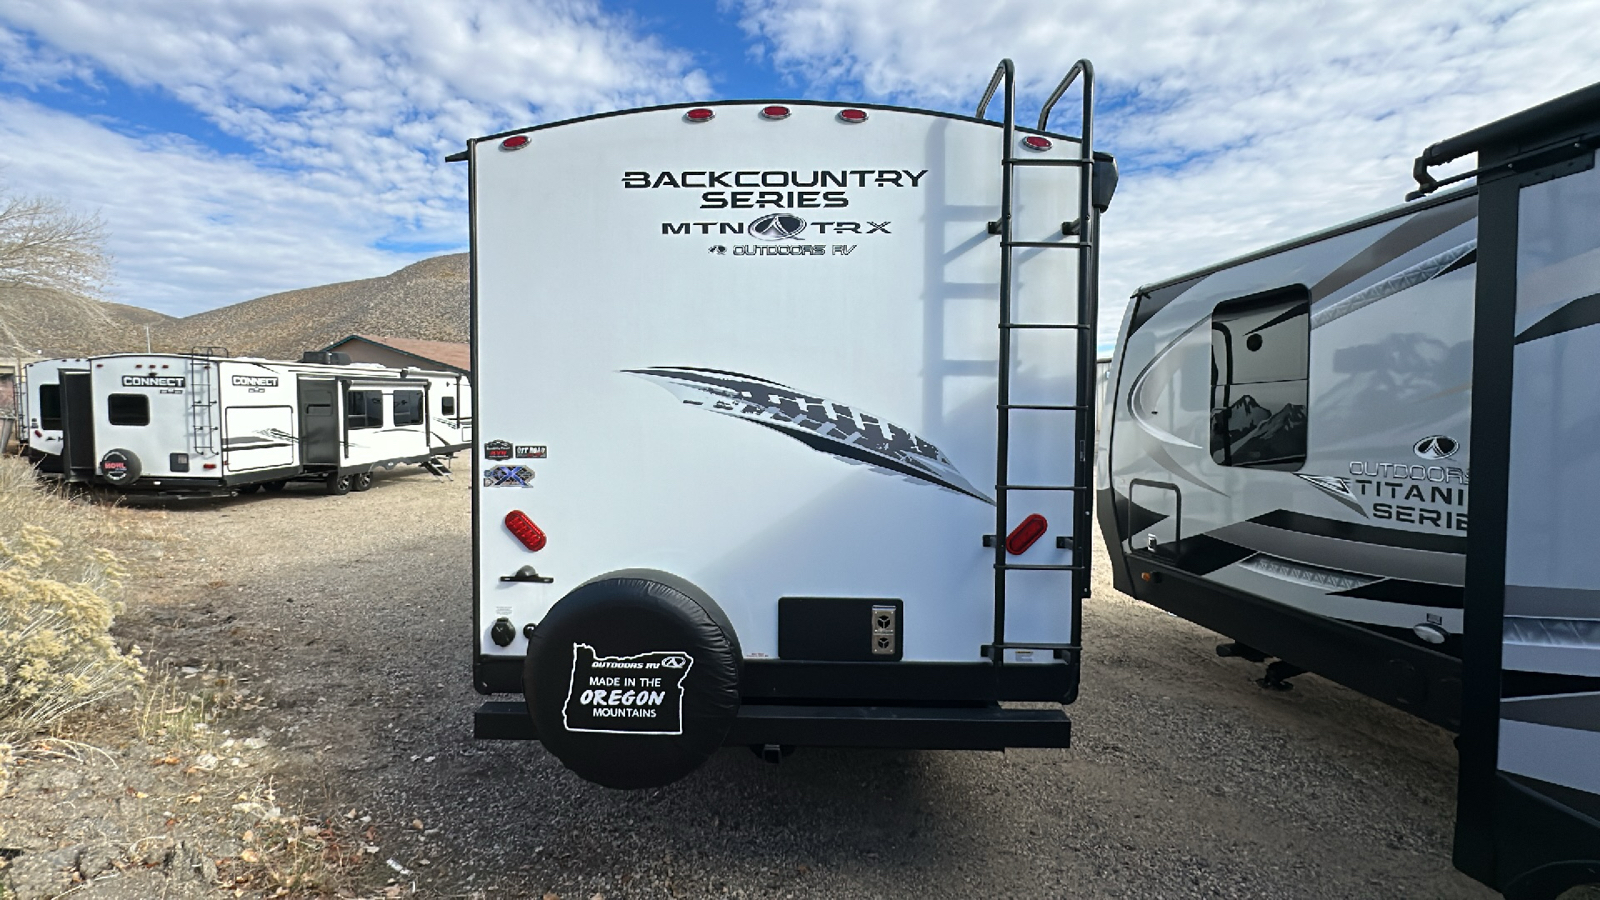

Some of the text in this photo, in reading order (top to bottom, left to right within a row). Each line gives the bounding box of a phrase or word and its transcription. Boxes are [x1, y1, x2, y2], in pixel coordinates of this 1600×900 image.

[621, 169, 929, 189] BACKCOUNTRY
[699, 190, 849, 209] SERIES
[661, 221, 892, 235] MTN TRX
[732, 244, 858, 256] OUTDOORS RV
[123, 376, 184, 387] CONNECT
[233, 376, 278, 387] CONNECT
[591, 661, 644, 669] OUTDOORS
[589, 676, 662, 688] MADE IN THE
[579, 689, 666, 706] OREGON
[592, 708, 657, 718] MOUNTAINS
